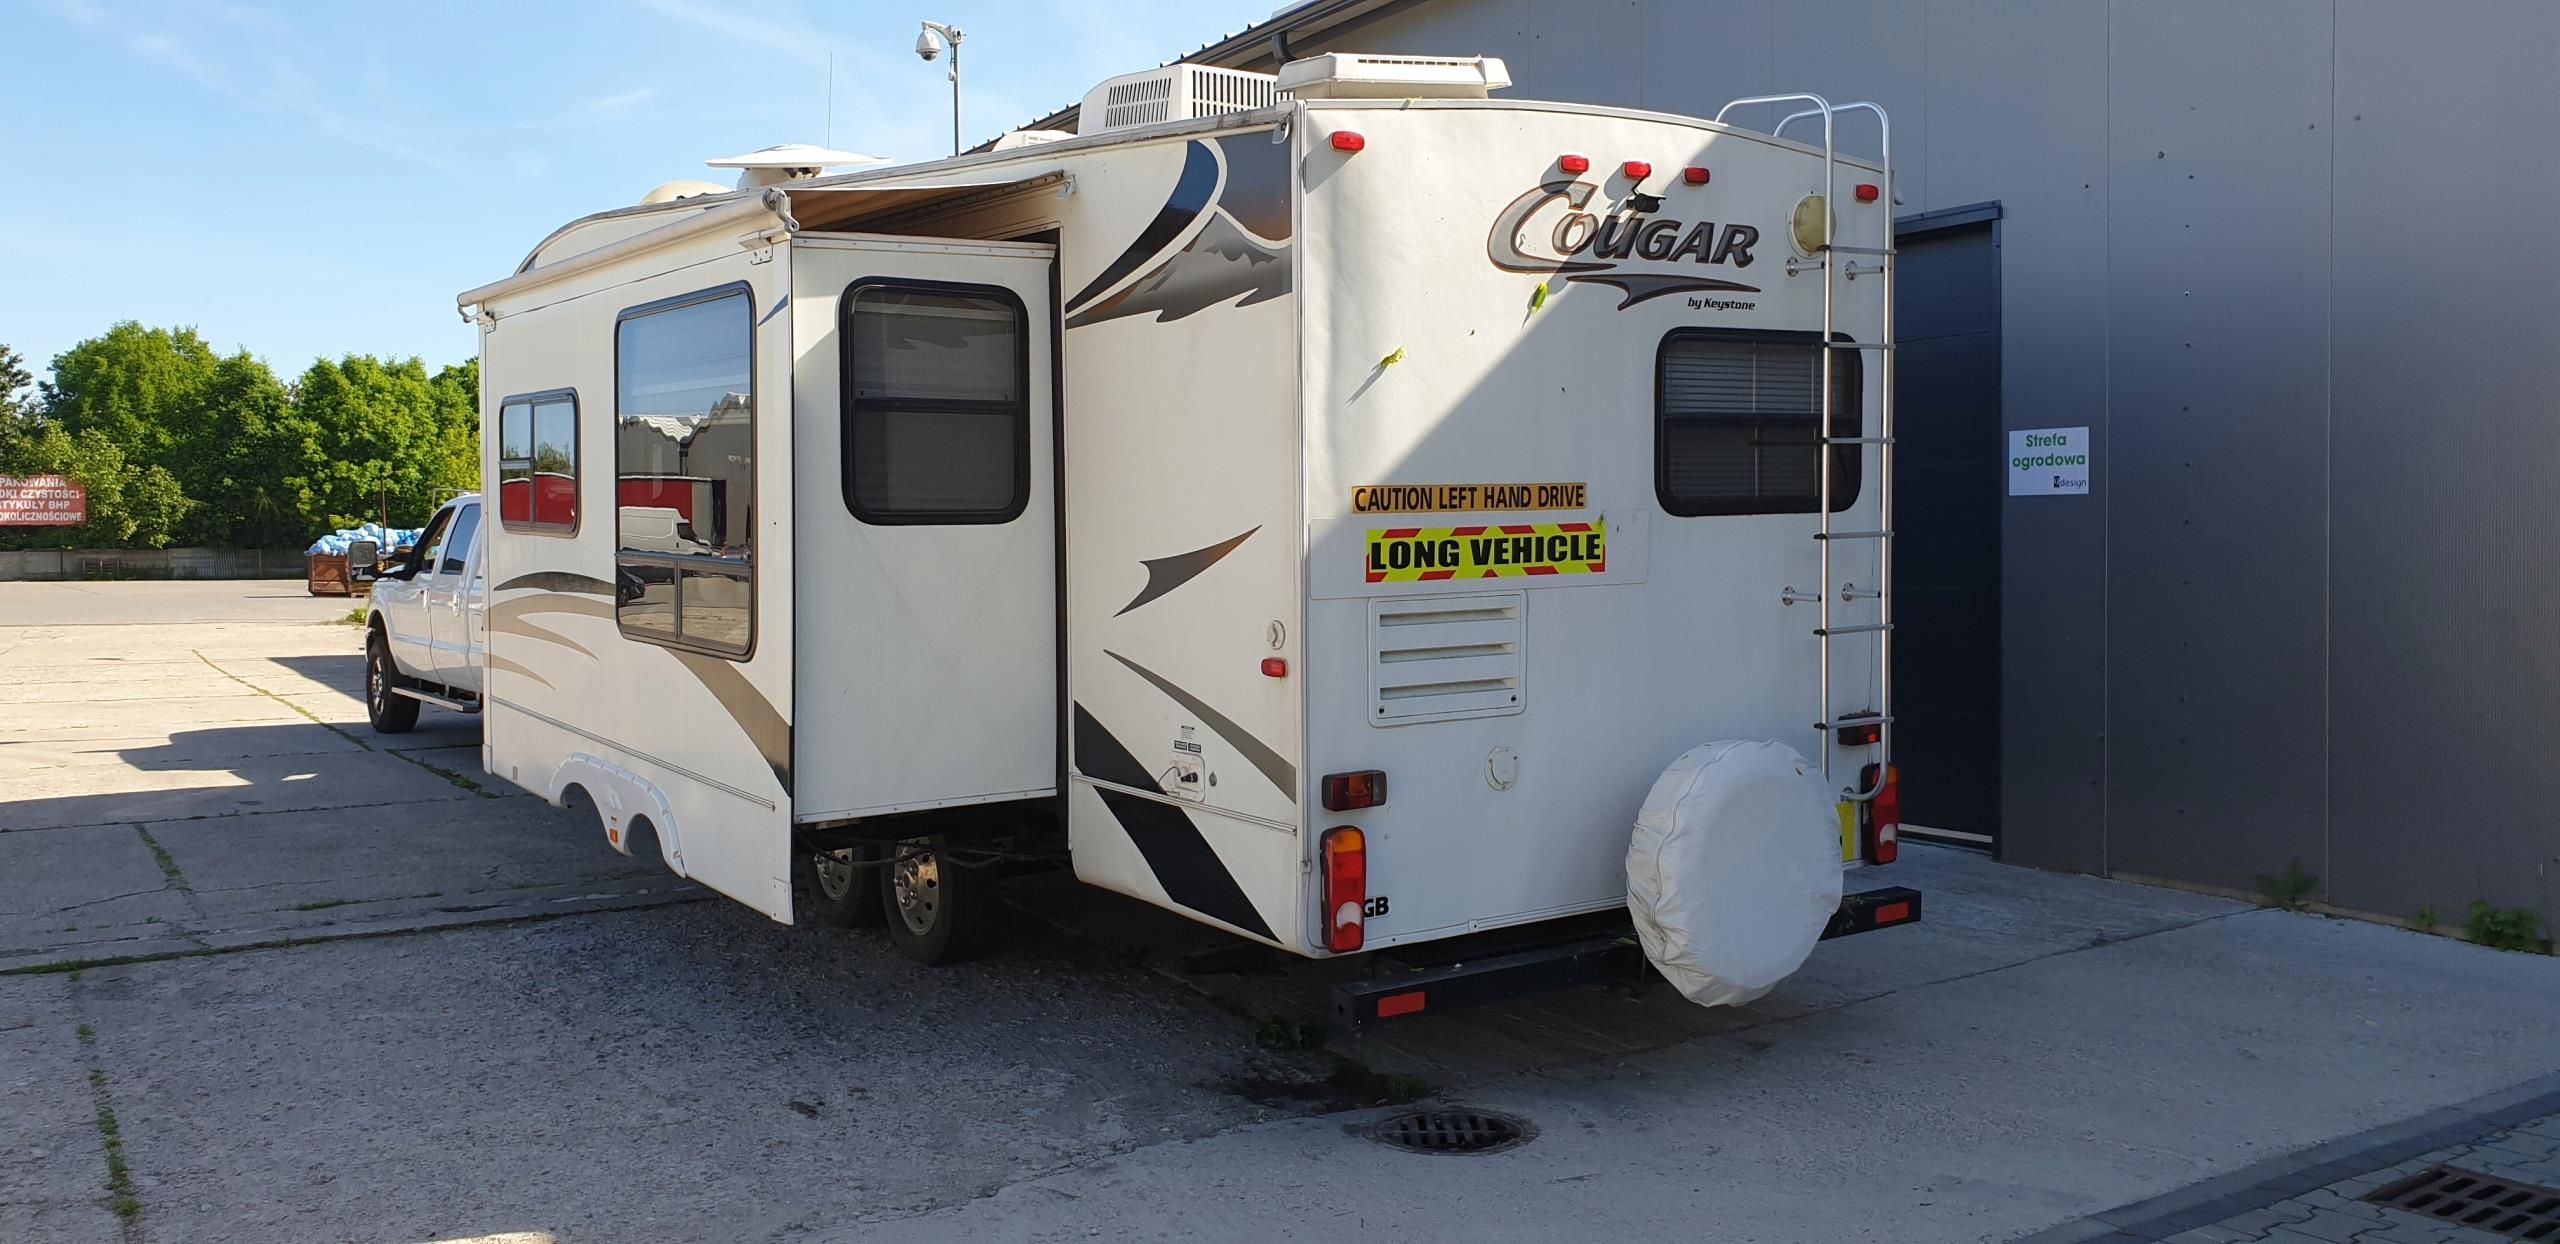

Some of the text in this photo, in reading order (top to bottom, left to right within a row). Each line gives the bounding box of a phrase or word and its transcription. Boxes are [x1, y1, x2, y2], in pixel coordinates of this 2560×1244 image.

[1687, 296, 1756, 311] by Keystone
[2025, 433, 2067, 448] Strefa
[2012, 453, 2085, 471] ogrodowa
[0, 500, 71, 510] TYKUŁY BHP
[1354, 485, 1585, 512] CAUTION LEFT HAND DRIVE
[1370, 533, 1601, 570] LONG VEHICLE
[1363, 896, 1390, 918] GB
